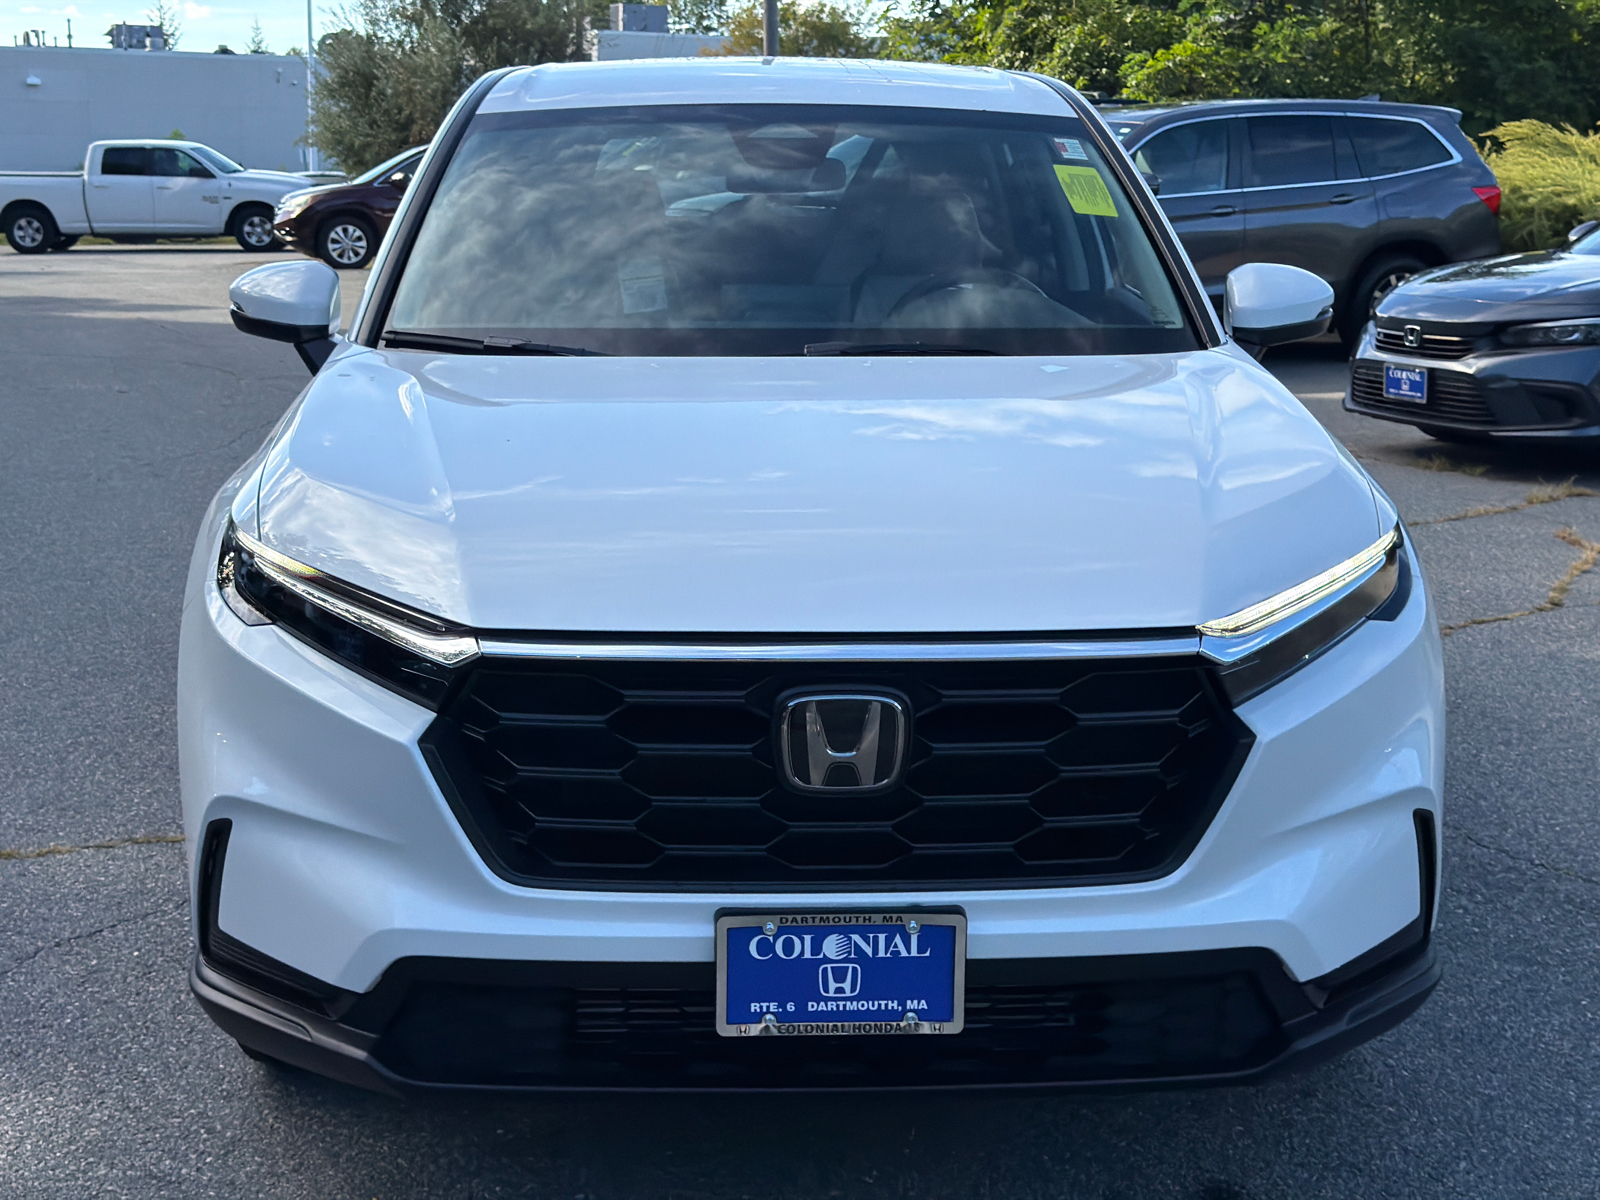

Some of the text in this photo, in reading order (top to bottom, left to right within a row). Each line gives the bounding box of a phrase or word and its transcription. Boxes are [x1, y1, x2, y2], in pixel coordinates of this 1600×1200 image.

[882, 915, 904, 924] MA
[749, 933, 931, 960] COLONIAL
[750, 999, 929, 1013] RTE. 6 DARTMOUTH, MA
[778, 1022, 902, 1035] COLONIAL HONDA
